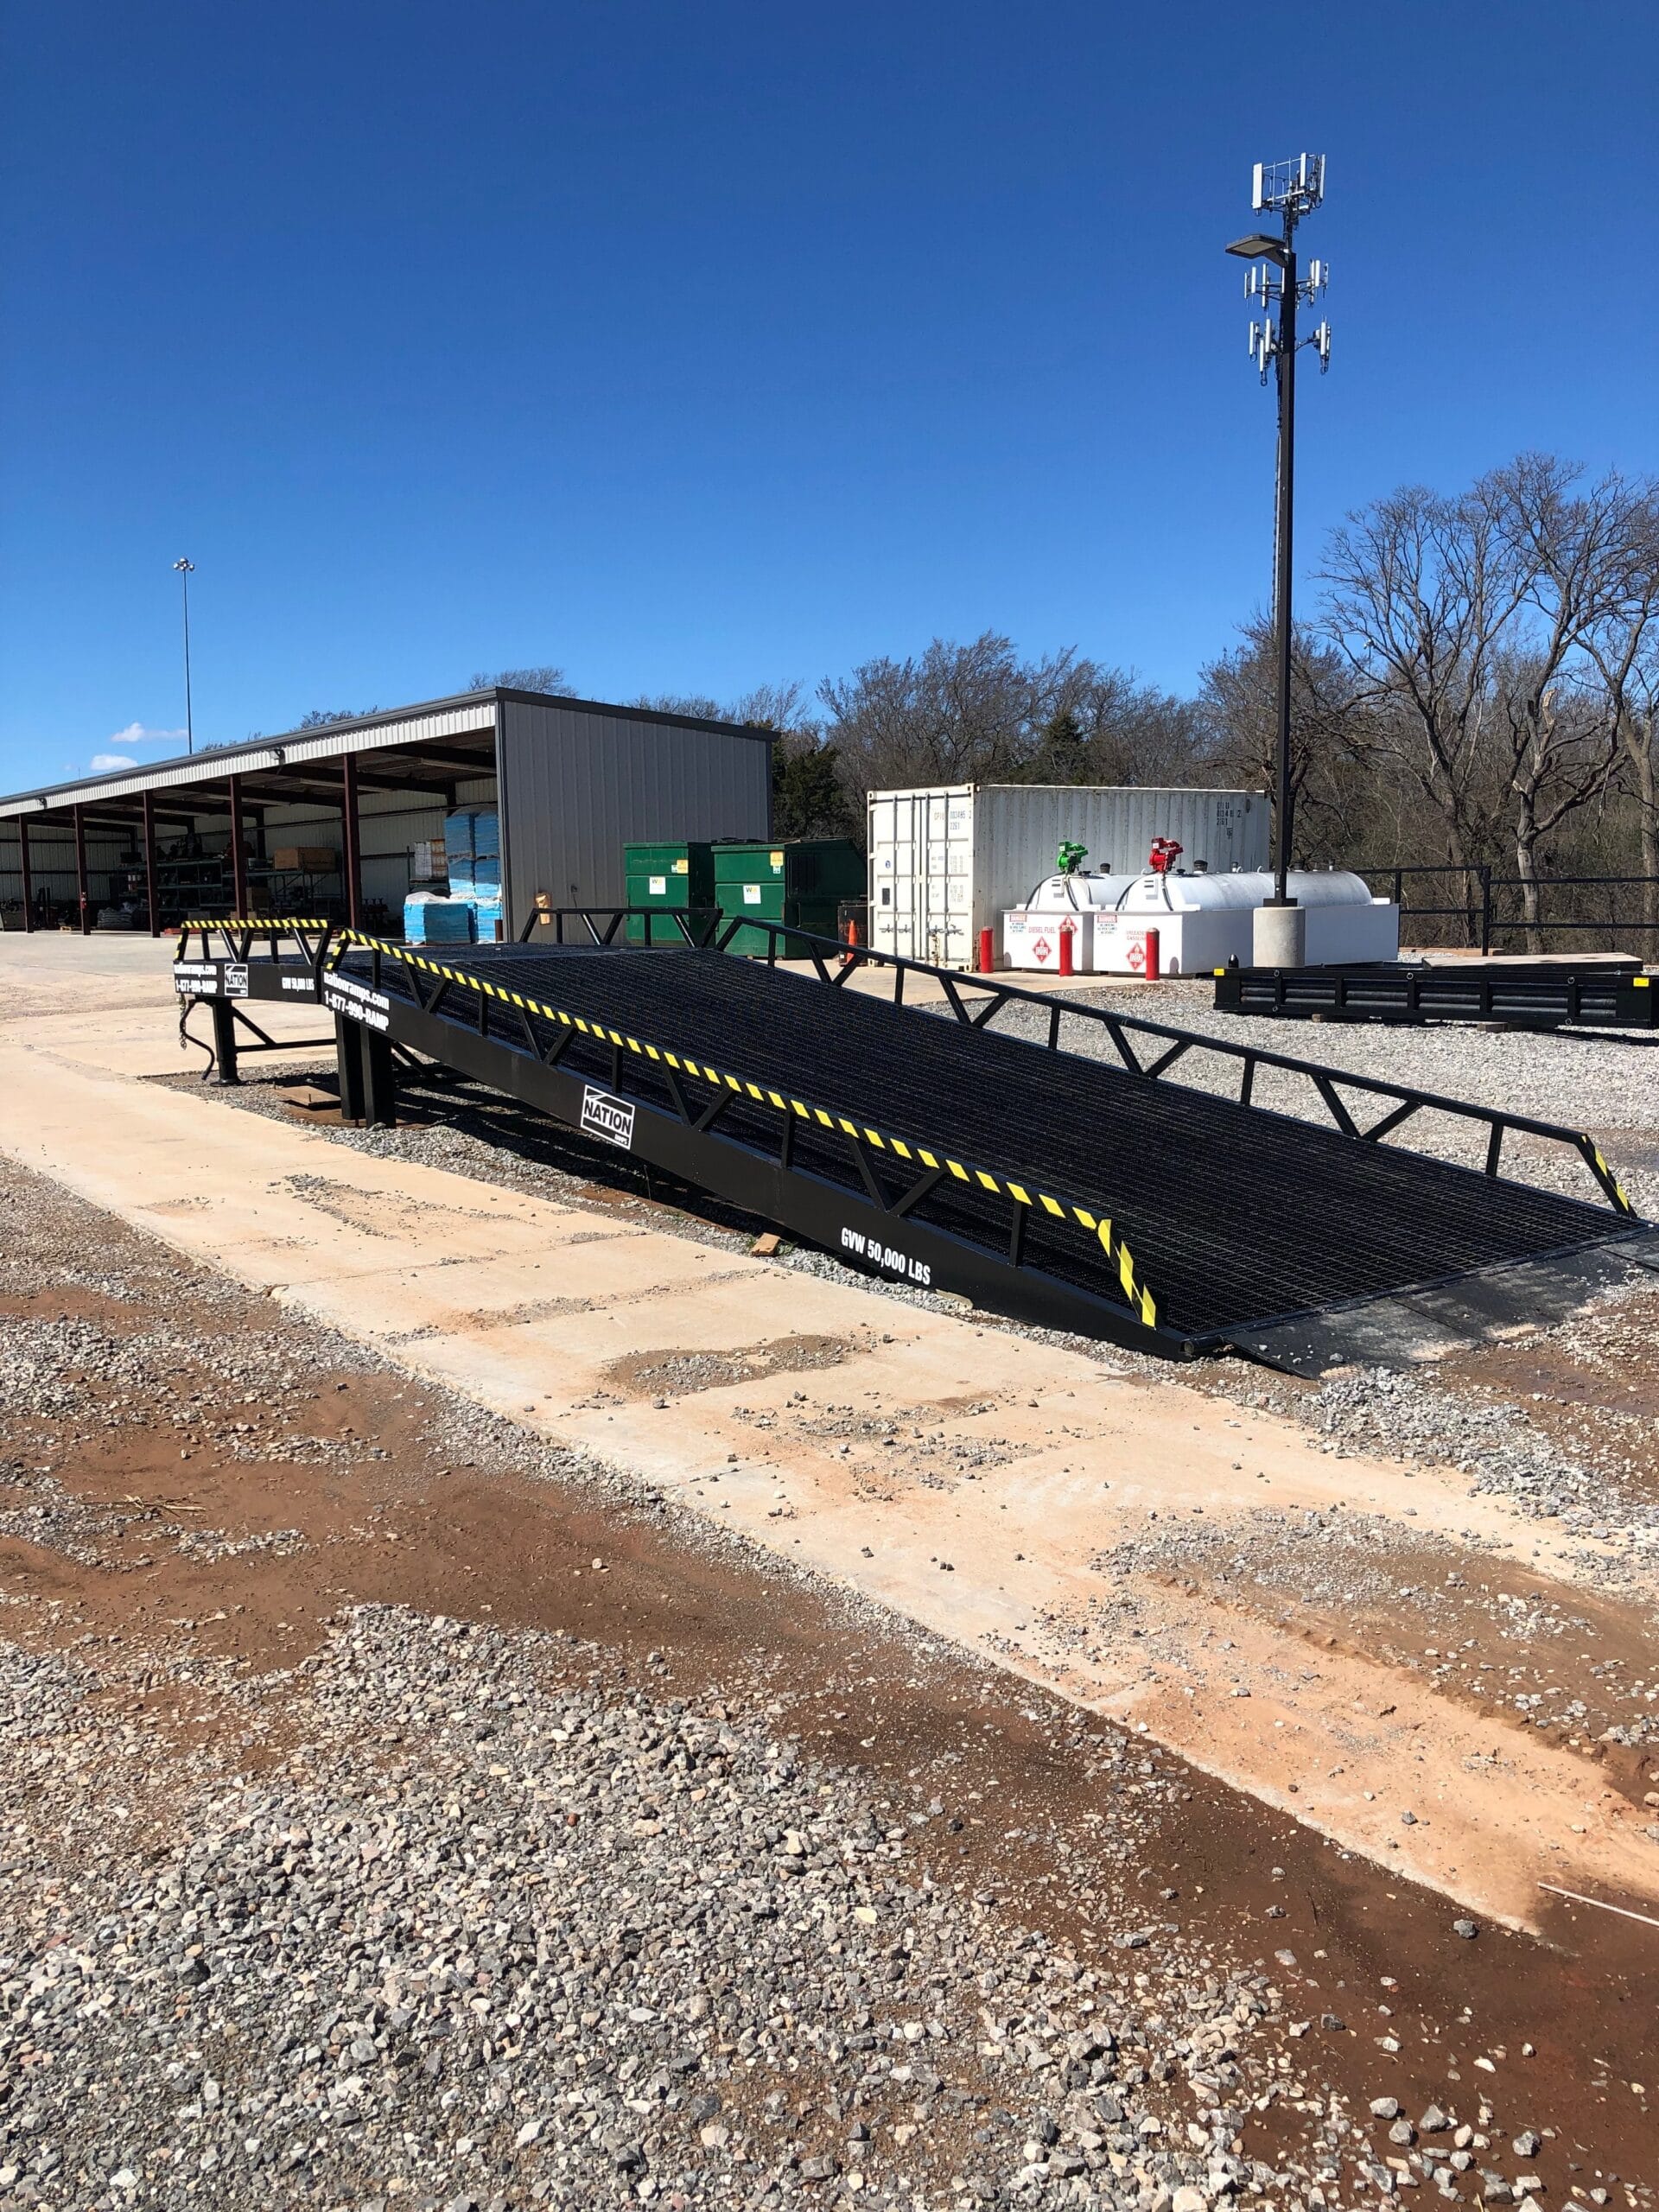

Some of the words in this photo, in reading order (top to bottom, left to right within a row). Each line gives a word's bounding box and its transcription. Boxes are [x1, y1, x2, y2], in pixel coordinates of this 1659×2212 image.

[226, 974, 247, 988] NATION
[324, 971, 390, 1010] nationramps.com
[325, 990, 389, 1032] 1-877-990-RAMP
[583, 1098, 632, 1136] NATION
[841, 1227, 866, 1255] GVW
[867, 1238, 906, 1274] 50,000
[908, 1257, 931, 1285] LBS
